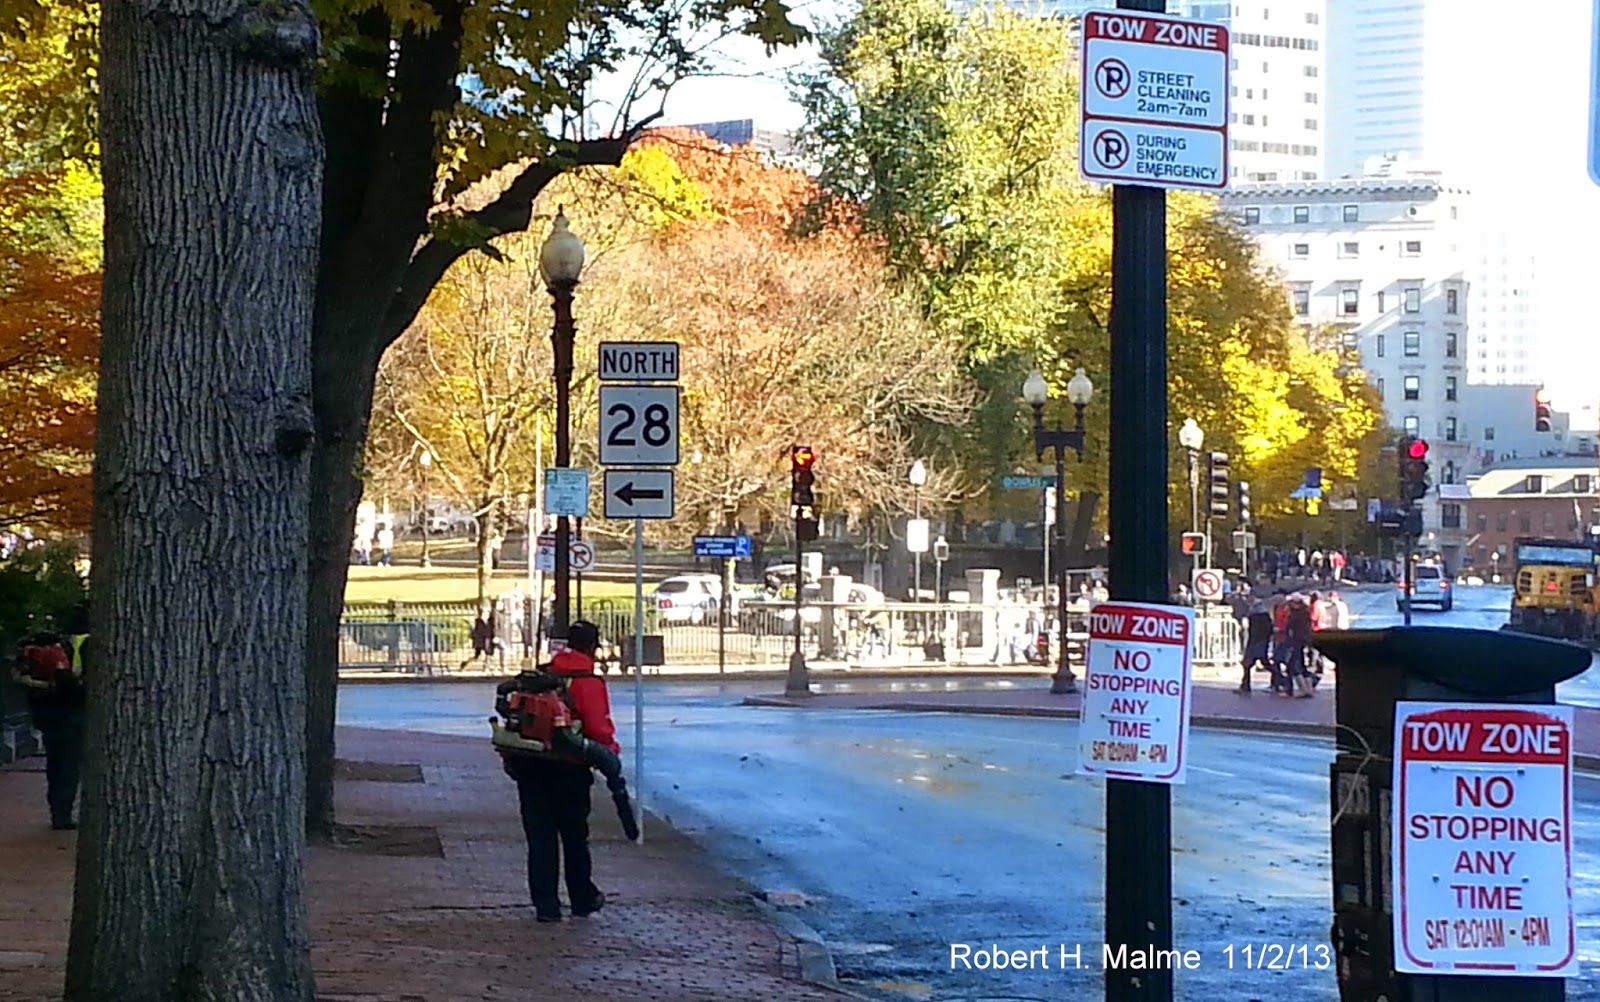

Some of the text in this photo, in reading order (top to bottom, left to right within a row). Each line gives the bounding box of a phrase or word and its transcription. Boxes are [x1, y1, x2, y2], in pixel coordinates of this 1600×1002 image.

[1094, 16, 1217, 47] TOW ZONE
[1138, 70, 1194, 88] STREET
[1137, 85, 1211, 103] CLEANING
[1137, 100, 1207, 117] 2am-7am
[1137, 134, 1186, 150] DURING
[1136, 148, 1177, 162] SNOW
[1136, 162, 1217, 180] EMERGENCY
[603, 350, 675, 374] NORTH
[606, 403, 671, 447] 28
[1092, 614, 1184, 639] TOW ZONE
[1114, 650, 1151, 672] NO
[1090, 674, 1180, 696] STOPPING
[1110, 698, 1149, 715] ANY
[1107, 719, 1151, 739] TIME
[1406, 722, 1561, 755] TOW ZONE
[1455, 776, 1514, 808] NO
[1409, 814, 1561, 842] STOPPING
[1454, 850, 1516, 875] ANY
[1450, 885, 1523, 911] TIME
[1425, 919, 1449, 950] SAT
[1522, 917, 1550, 946] 4PM
